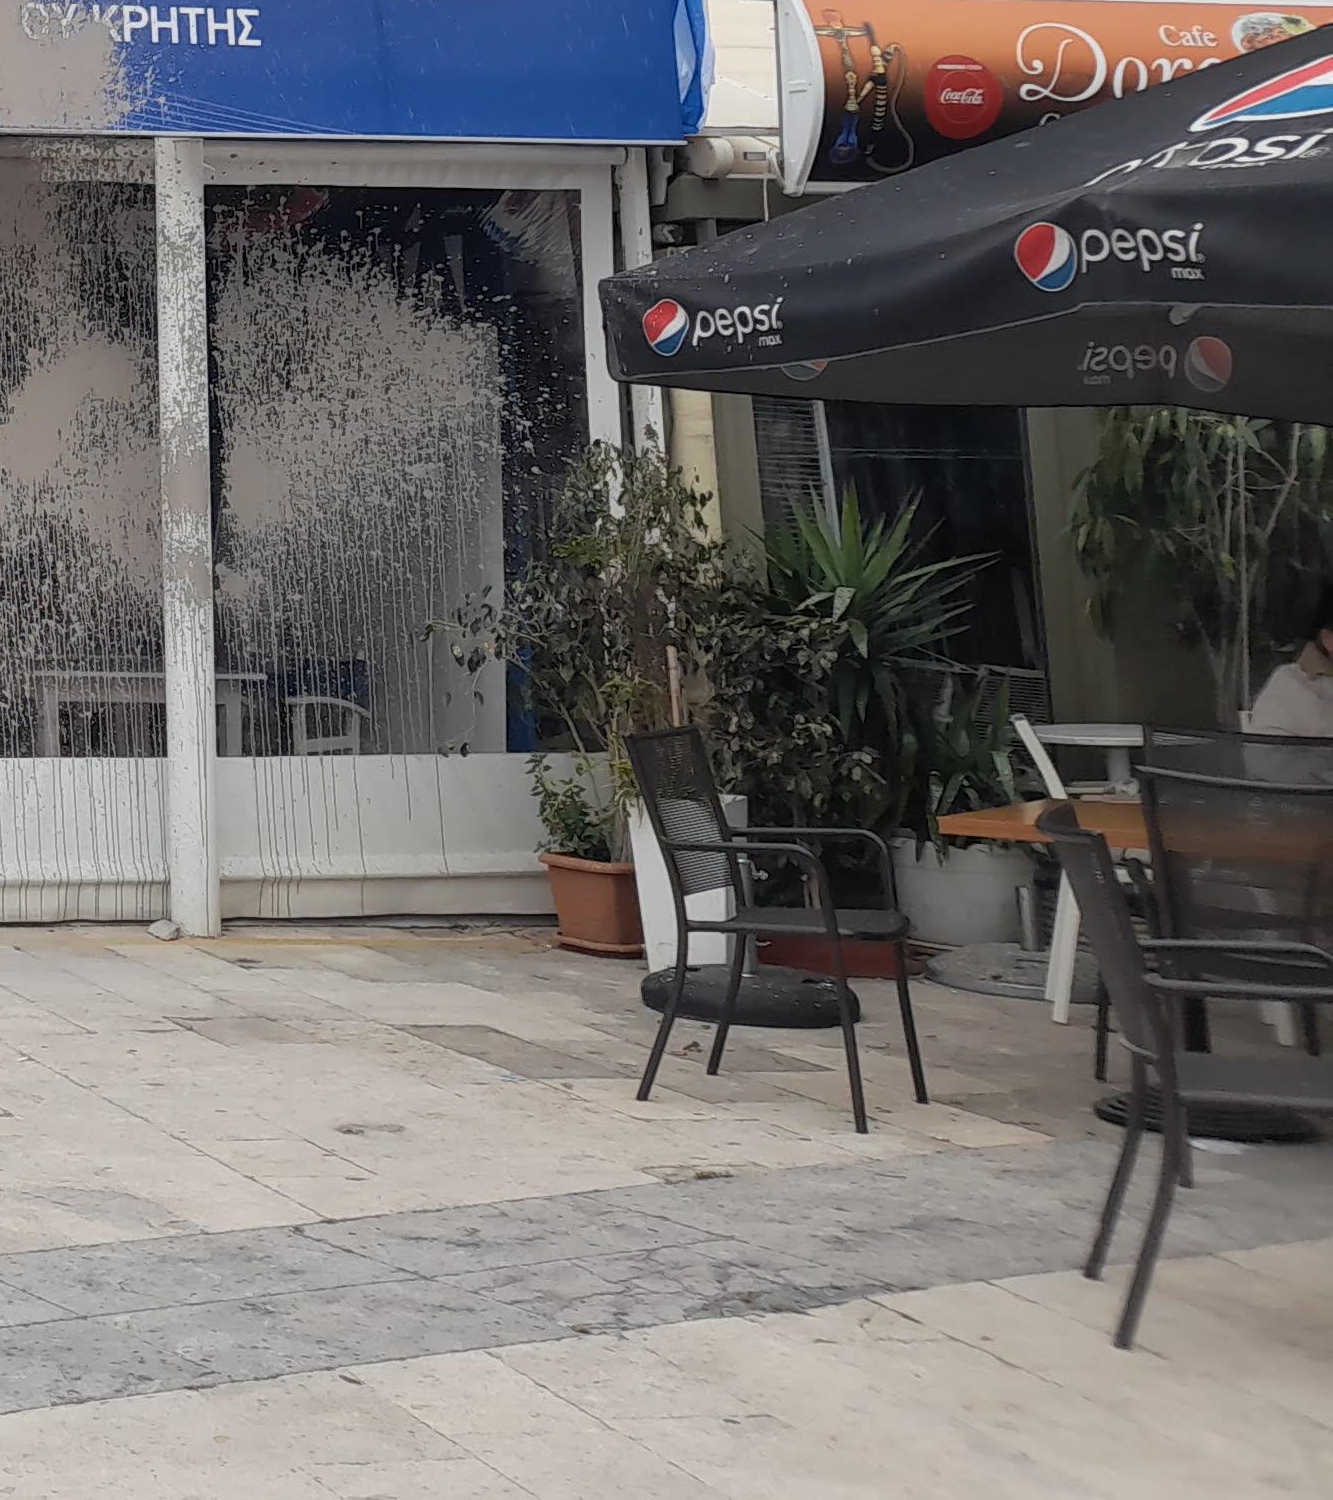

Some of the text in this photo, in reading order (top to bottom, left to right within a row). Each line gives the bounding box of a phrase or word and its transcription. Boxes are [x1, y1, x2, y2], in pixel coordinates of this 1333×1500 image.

[1158, 24, 1219, 48] Cafe
[1016, 22, 1224, 102] Dor
[1080, 222, 1204, 274] pepsi
[1170, 267, 1206, 280] max
[691, 297, 783, 347] pepsi
[758, 334, 783, 348] max
